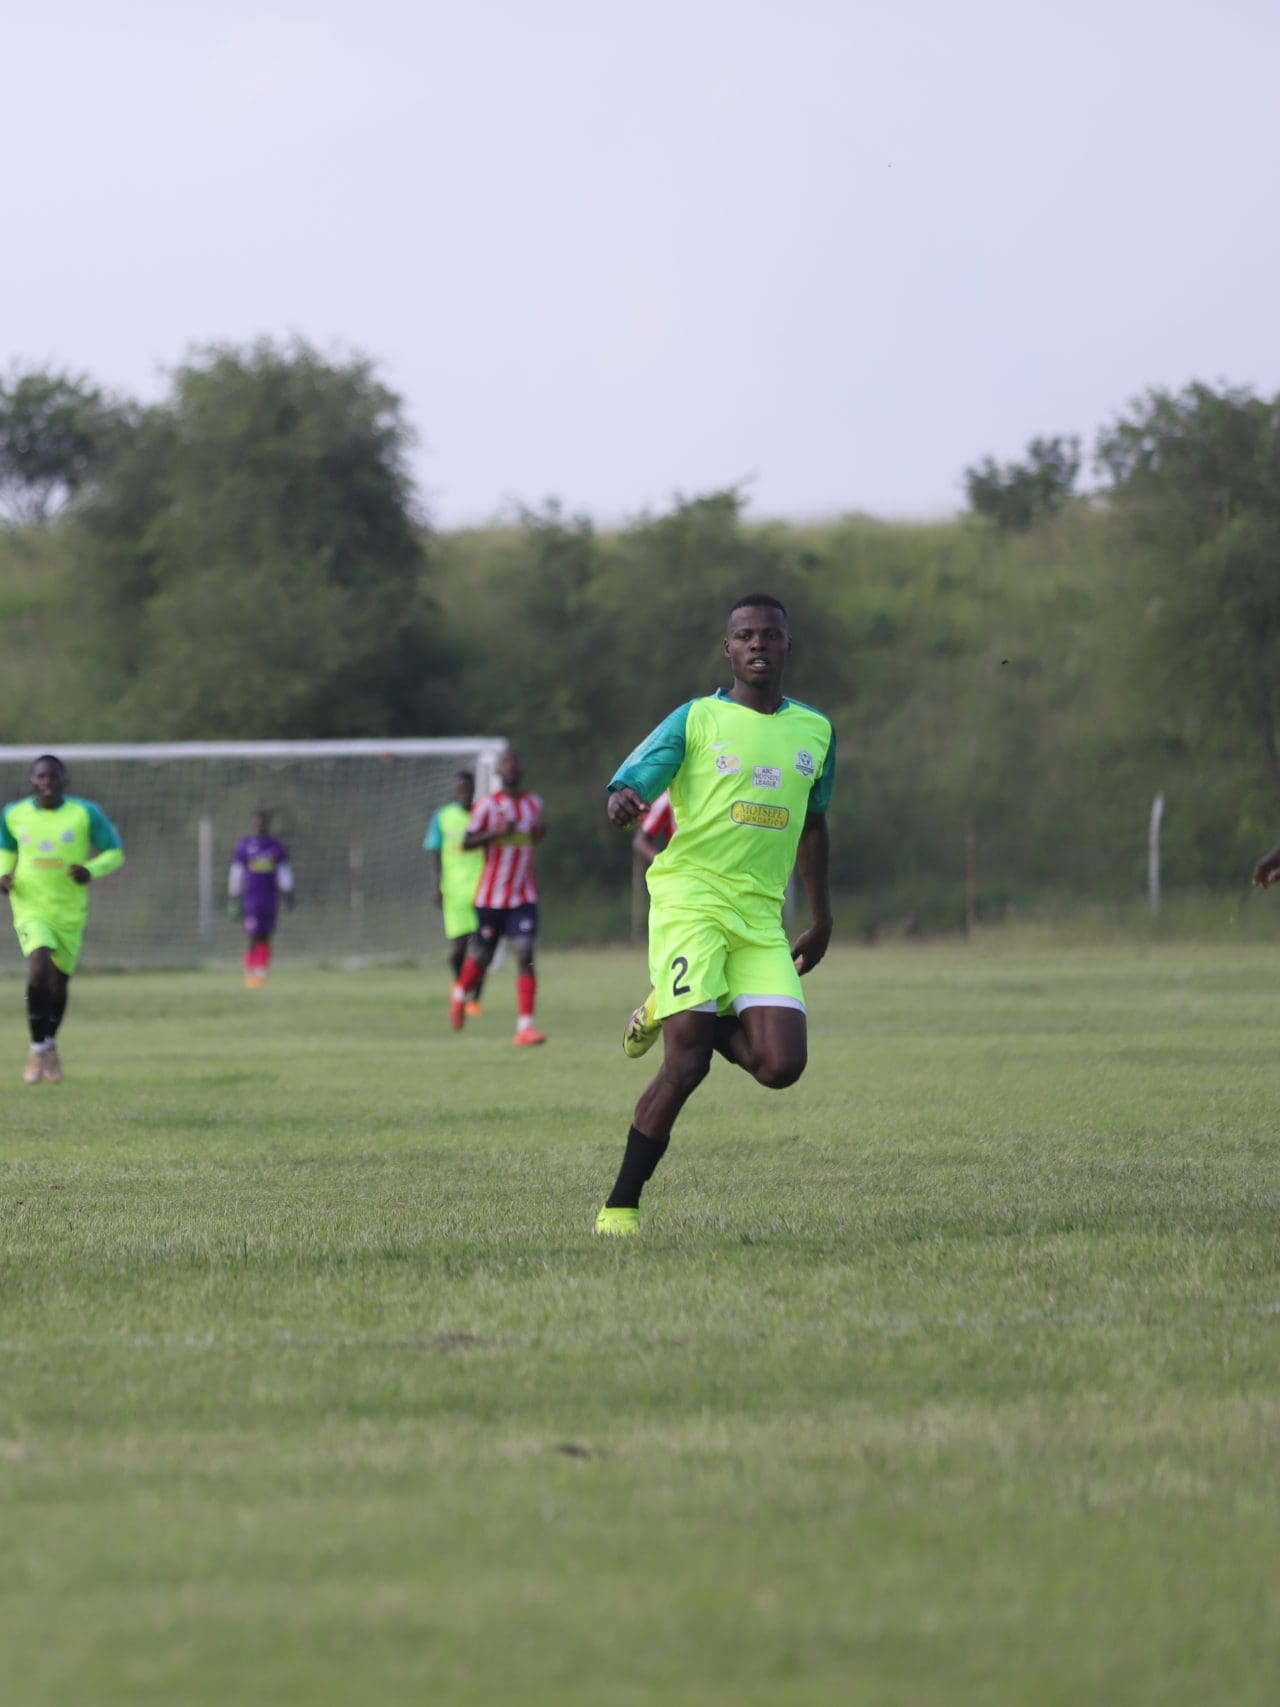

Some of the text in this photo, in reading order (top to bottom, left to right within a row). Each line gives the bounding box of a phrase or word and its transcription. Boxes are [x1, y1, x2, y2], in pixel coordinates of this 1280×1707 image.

[735, 813, 785, 827] FOUNDATION
[740, 803, 784, 820] MOTSEPE
[671, 956, 691, 997] 2
